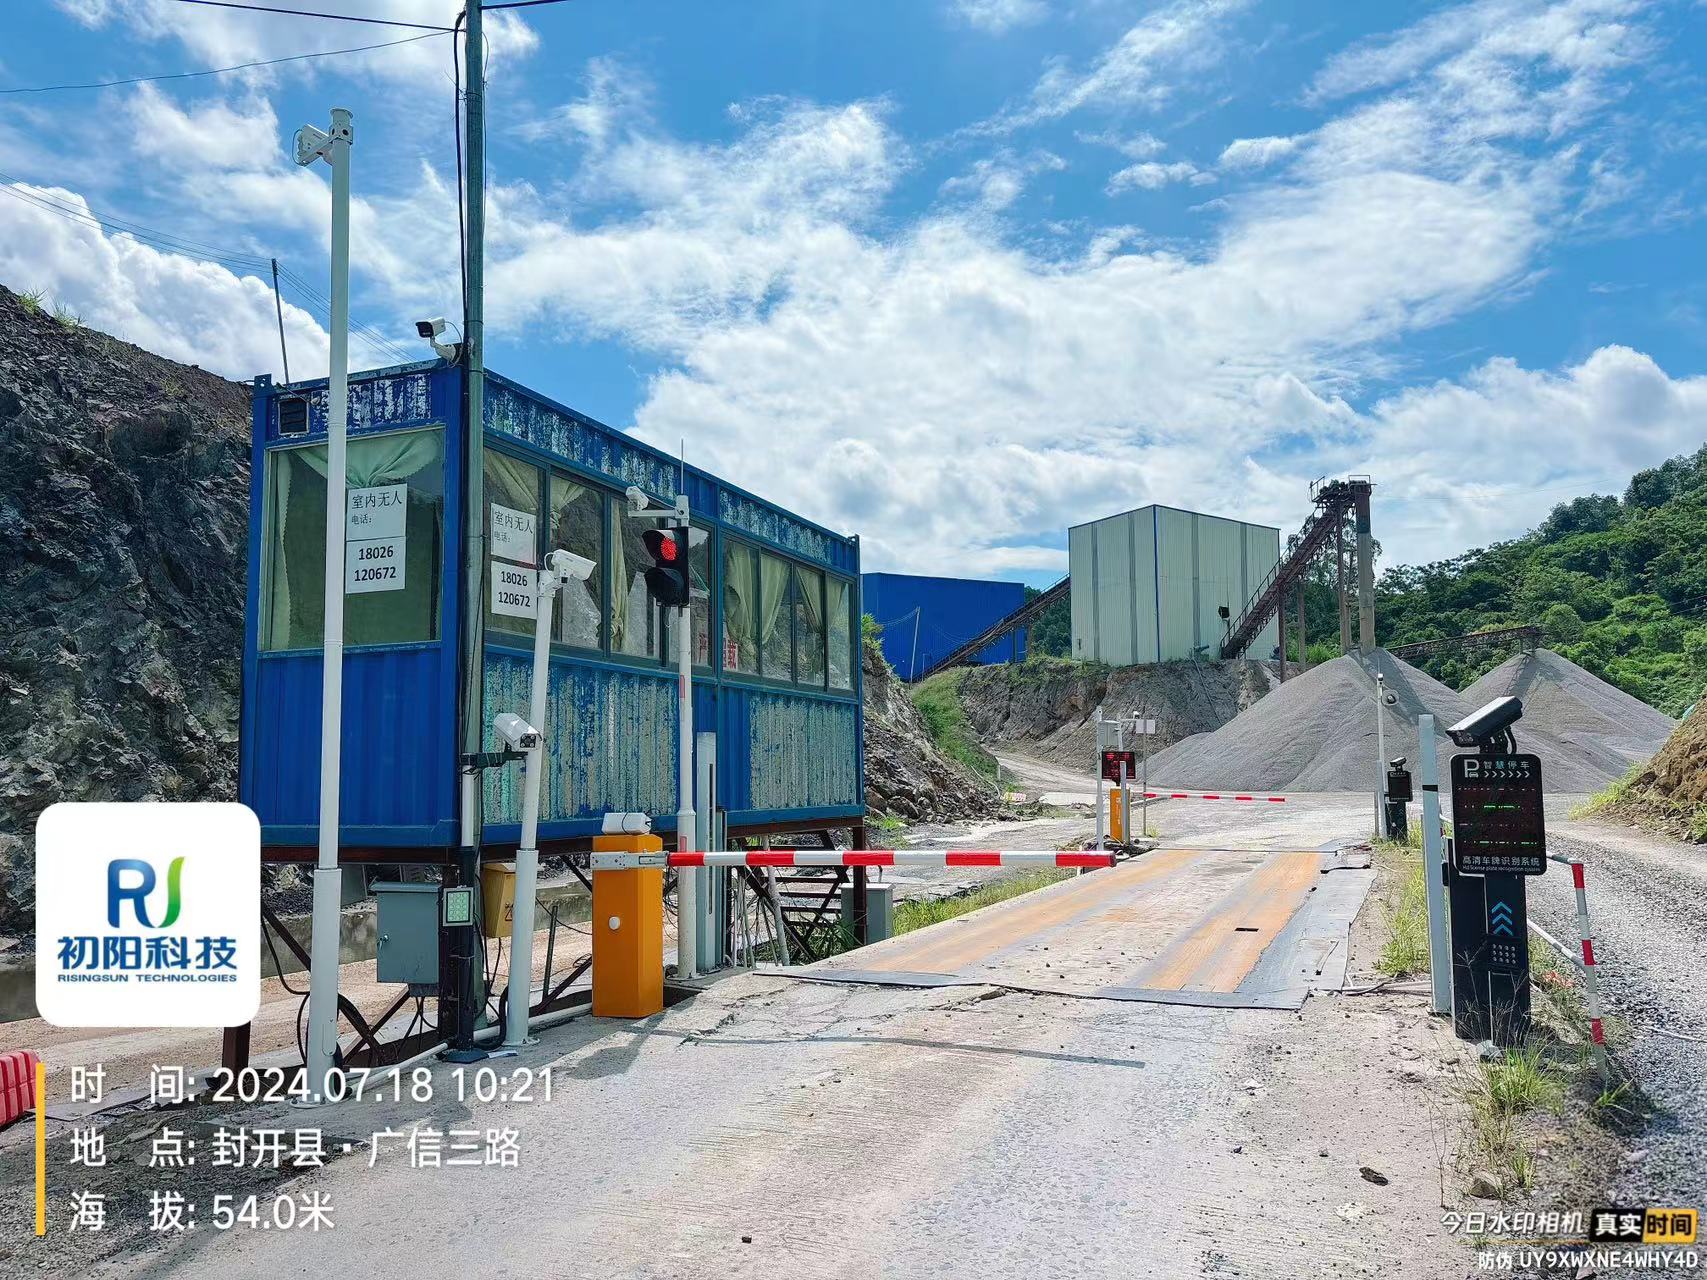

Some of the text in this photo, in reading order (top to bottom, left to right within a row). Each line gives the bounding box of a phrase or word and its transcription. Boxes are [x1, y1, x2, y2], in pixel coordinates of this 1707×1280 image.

[351, 490, 403, 510] 室内无人
[494, 510, 534, 535] 室内无人
[358, 545, 394, 561] 18026
[354, 567, 397, 582] 120672
[501, 570, 528, 587] 18026
[498, 592, 531, 608] 120672
